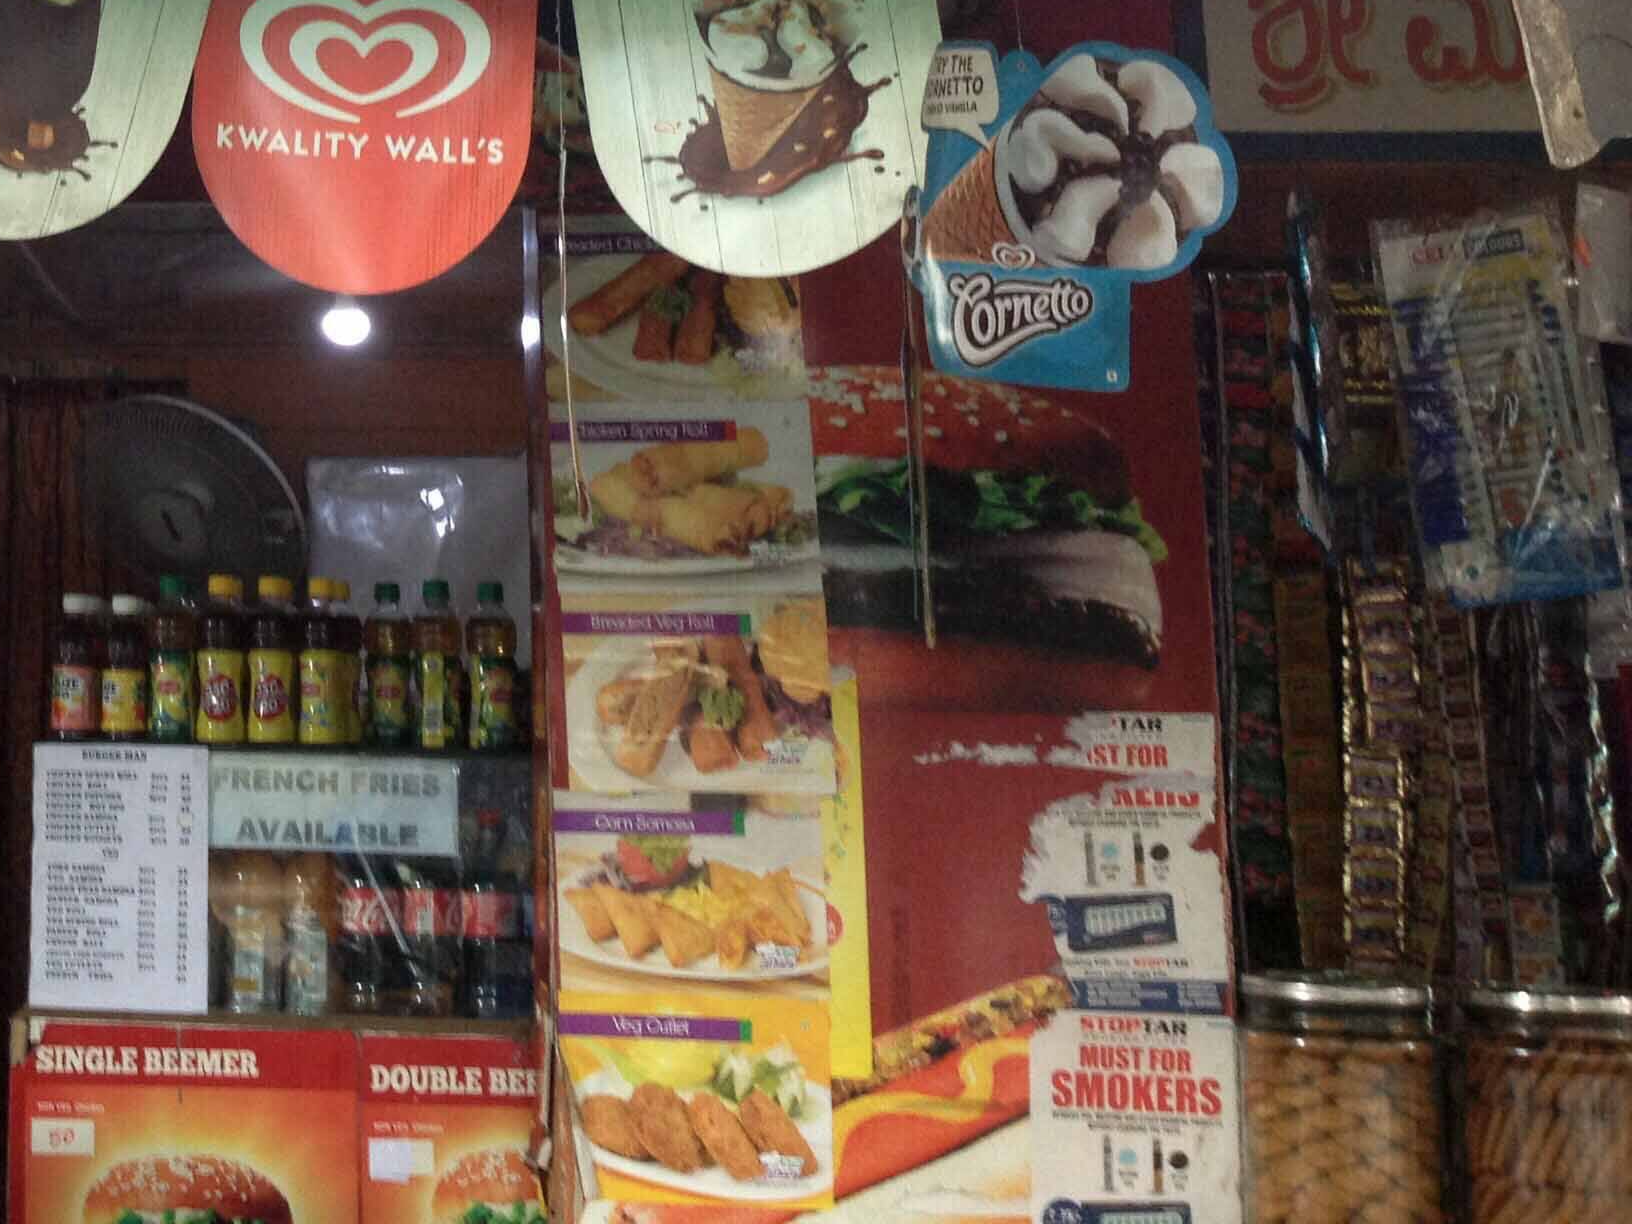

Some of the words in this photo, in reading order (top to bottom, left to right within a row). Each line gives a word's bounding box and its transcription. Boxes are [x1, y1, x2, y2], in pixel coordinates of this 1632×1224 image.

[951, 54, 974, 72] THE
[216, 123, 370, 162] KWALITY
[385, 134, 505, 166] WALL'S
[950, 275, 1094, 366] Cornetto
[1111, 717, 1163, 733] TAR
[1126, 744, 1169, 768] FOR
[212, 767, 340, 794] FRENCH
[350, 770, 443, 798] FRIES
[237, 817, 419, 847] AVAILABLE
[611, 1018, 642, 1036] Veg
[35, 1046, 139, 1076] SINGLE
[142, 1047, 260, 1078] BEEMER
[1079, 1045, 1145, 1071] MUST
[1150, 1047, 1192, 1073] FOR
[370, 1065, 483, 1096] DOUBLE
[488, 1068, 537, 1098] BEE
[1051, 1068, 1223, 1116] SMOKERS
